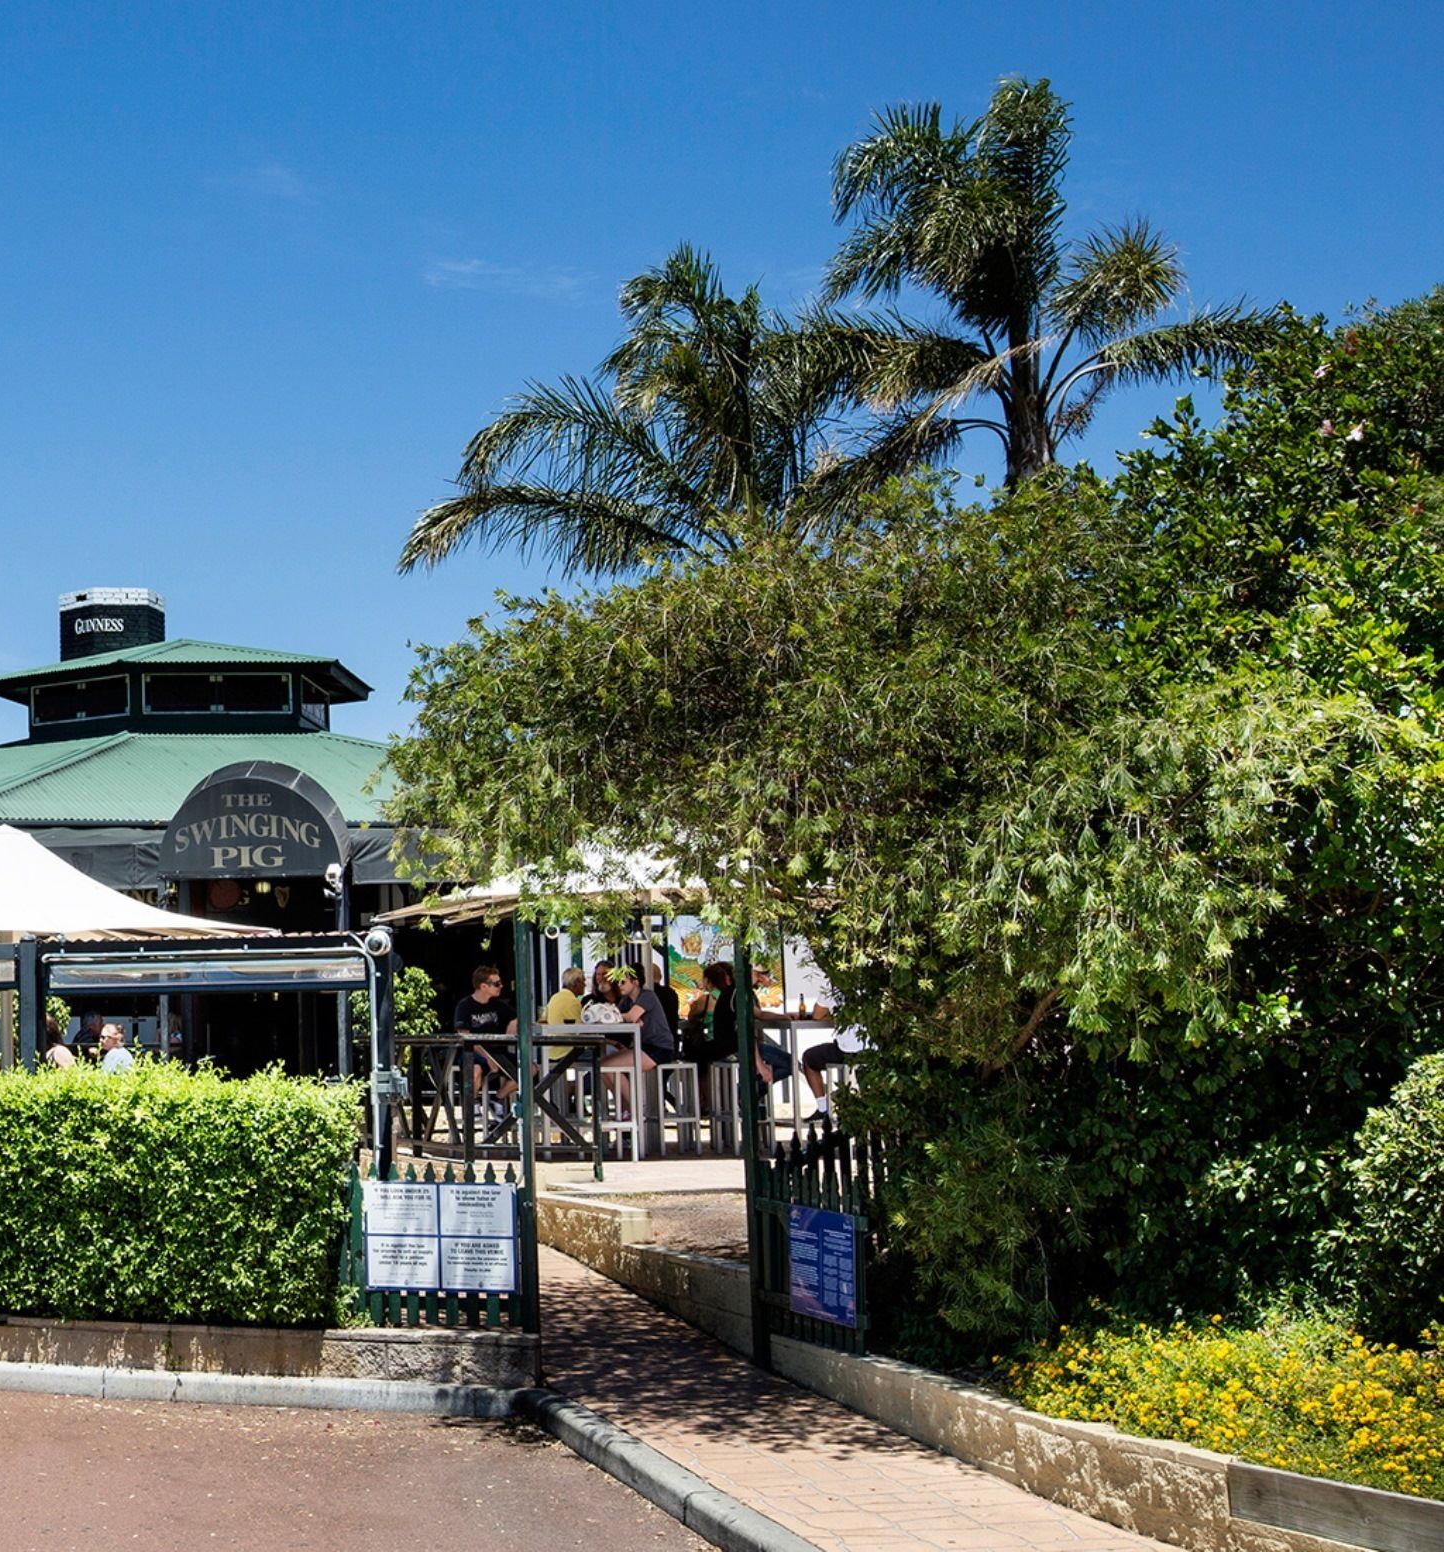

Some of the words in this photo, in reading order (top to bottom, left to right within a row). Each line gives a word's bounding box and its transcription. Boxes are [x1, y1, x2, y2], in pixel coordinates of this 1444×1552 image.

[74, 618, 124, 634] GUINNESS
[221, 793, 272, 808] THE
[174, 812, 321, 853] SWINGING
[209, 845, 287, 869] PIG
